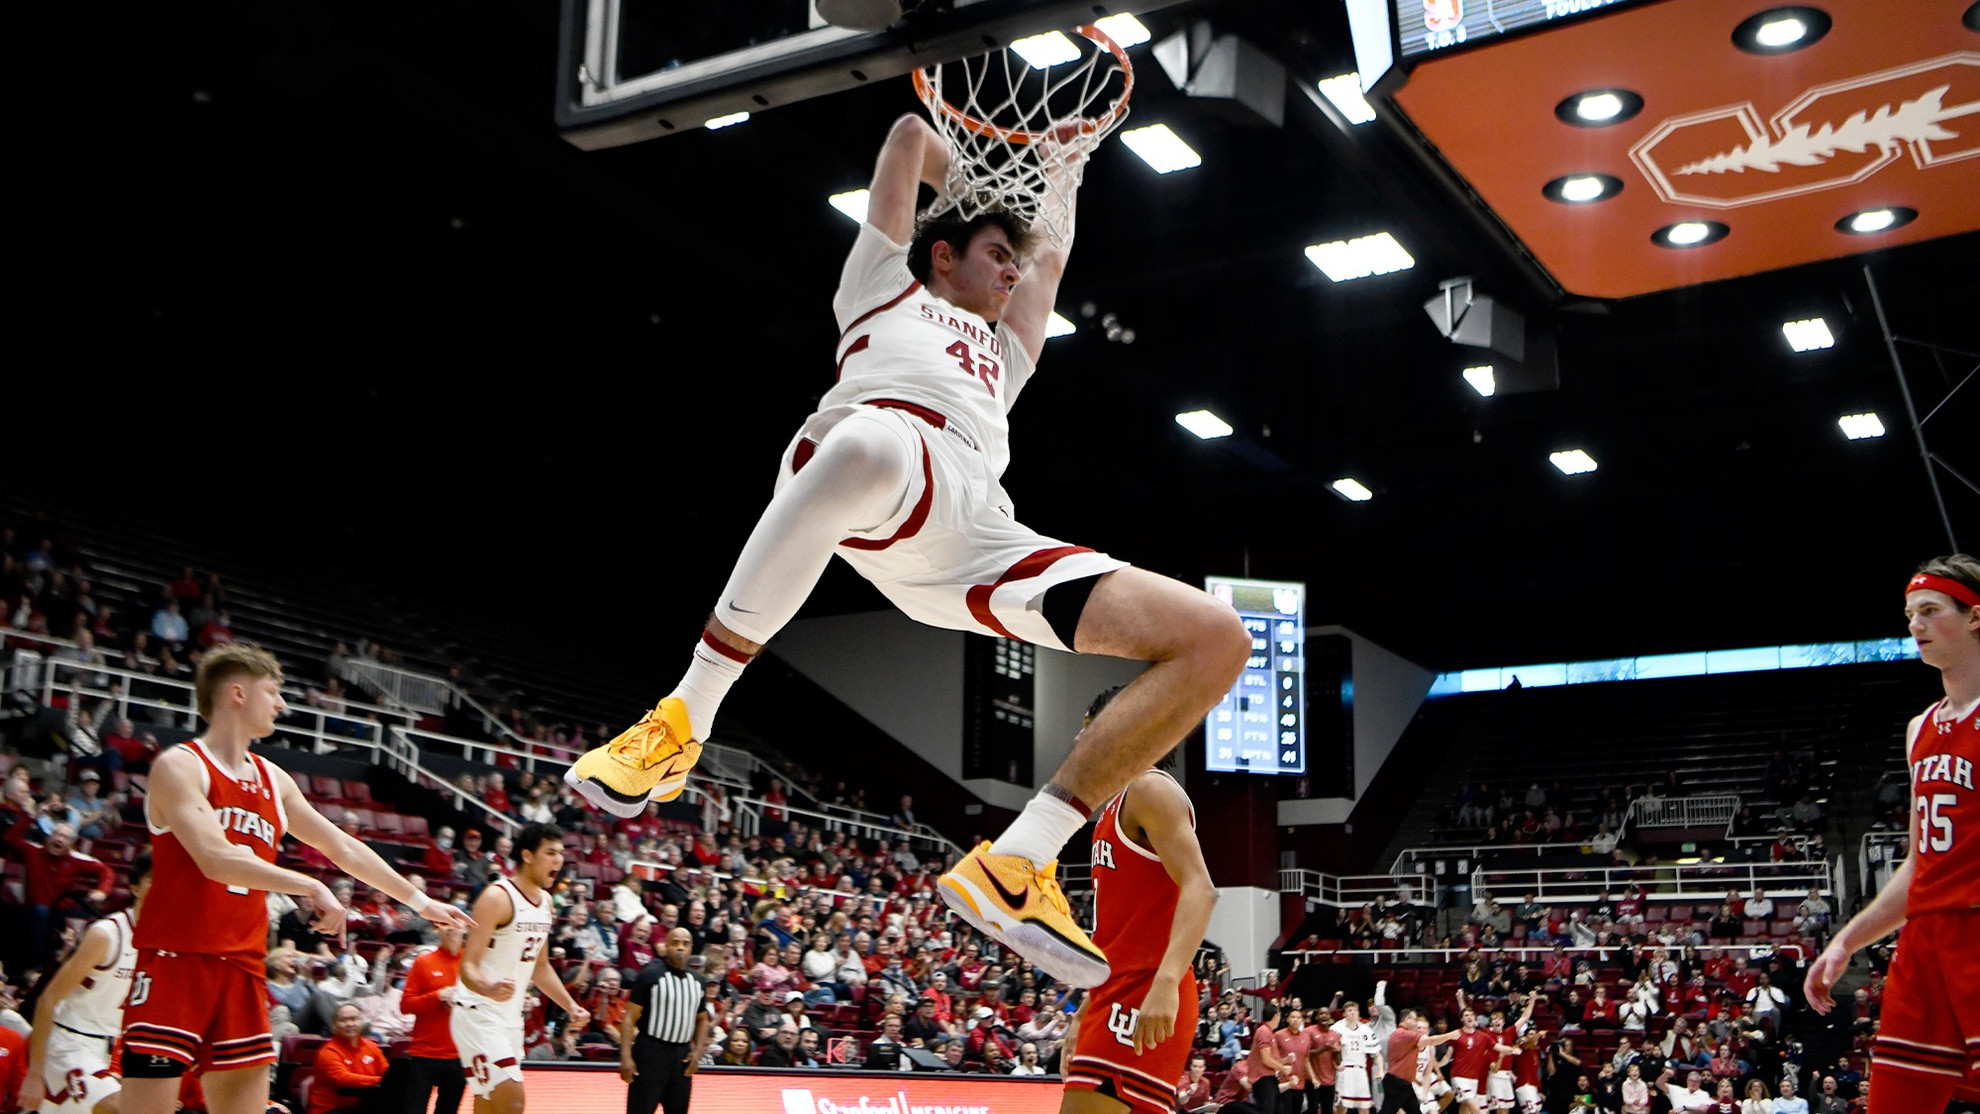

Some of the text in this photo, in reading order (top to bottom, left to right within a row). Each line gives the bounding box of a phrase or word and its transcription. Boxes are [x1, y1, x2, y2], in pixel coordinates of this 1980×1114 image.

[920, 304, 1004, 360] STANFO
[945, 339, 1000, 399] 42
[947, 424, 973, 448] CARDINAL
[1244, 619, 1266, 632] PTS
[1252, 638, 1267, 650] EB
[1244, 674, 1267, 687] STL
[1248, 693, 1293, 708] TO 4
[1244, 730, 1269, 742] FT%
[1282, 750, 1297, 763] 41
[214, 806, 275, 850] UTAH
[1917, 793, 1957, 854] 35
[1091, 838, 1117, 870] AH
